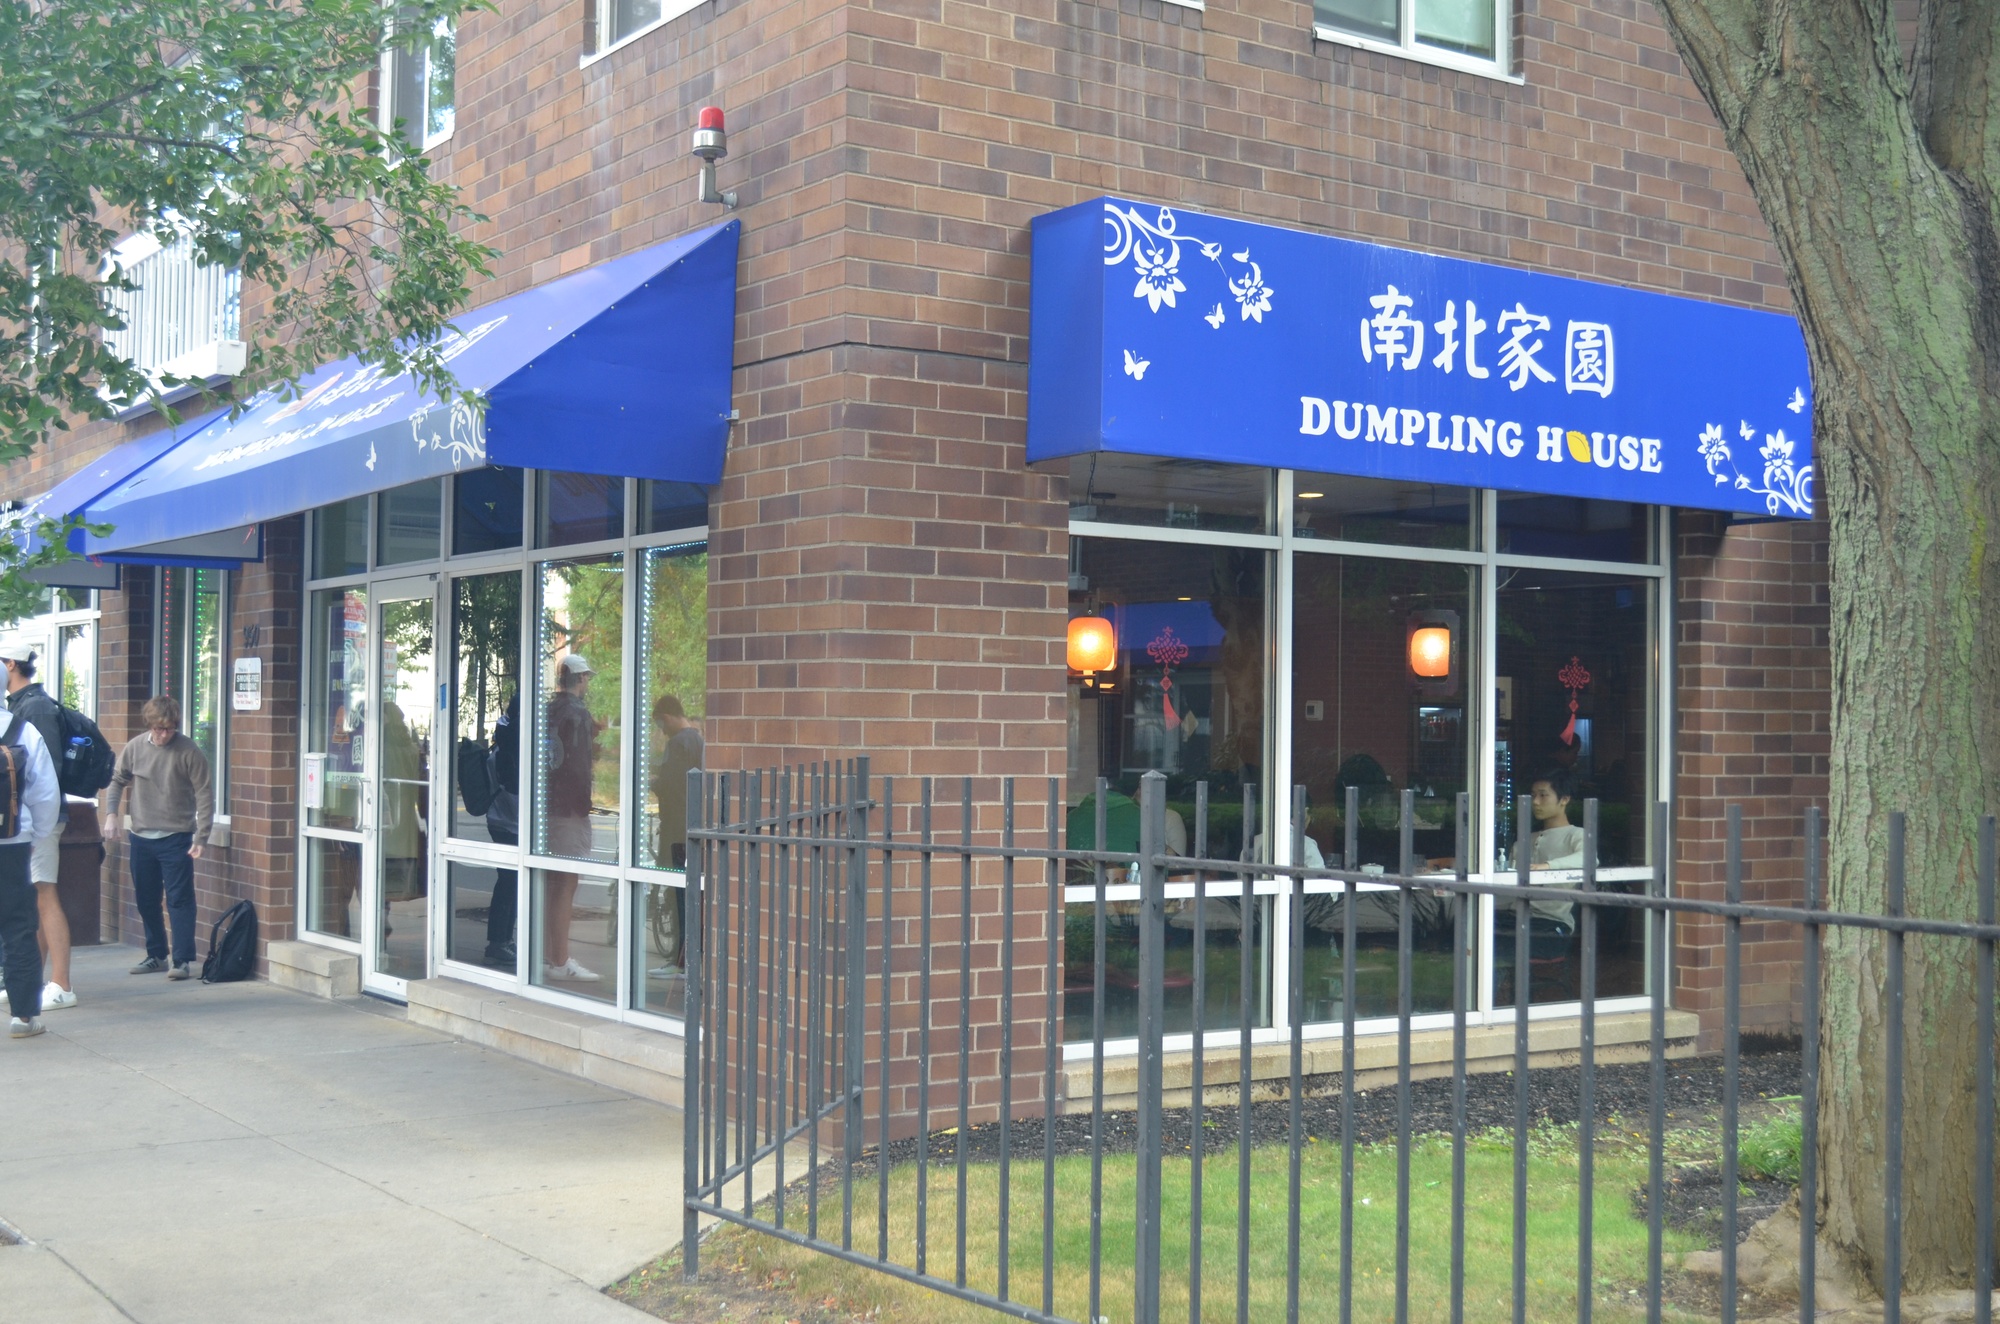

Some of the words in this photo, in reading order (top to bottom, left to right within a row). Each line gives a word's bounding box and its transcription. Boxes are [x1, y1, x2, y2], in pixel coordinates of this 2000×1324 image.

[1359, 284, 1615, 399] 南北家園
[1299, 396, 1524, 457] DUMPLING
